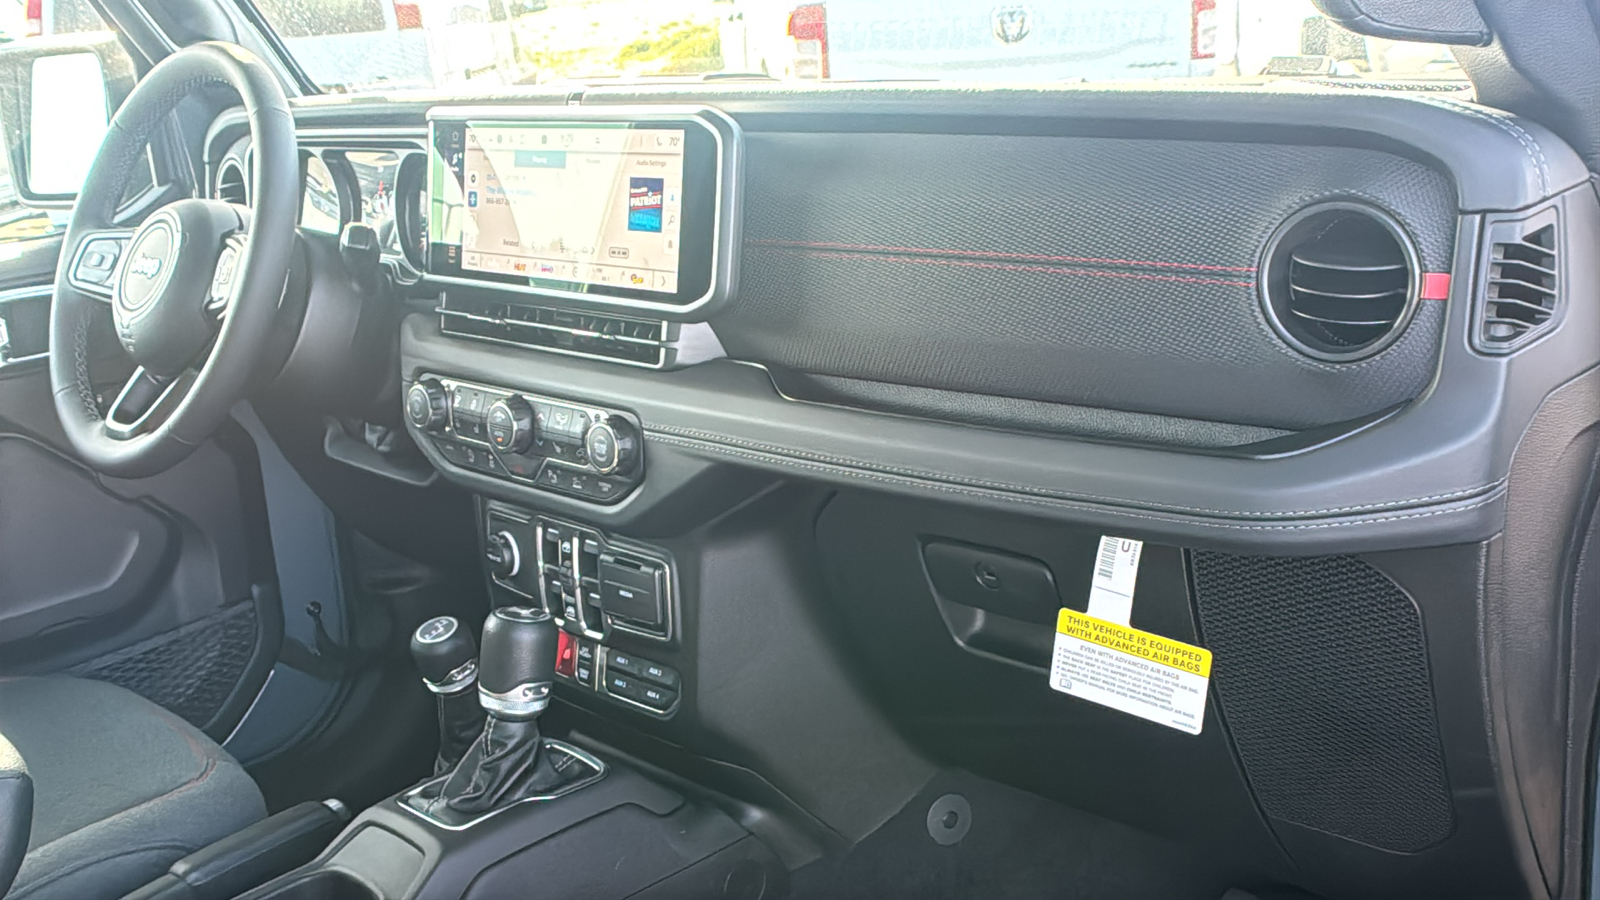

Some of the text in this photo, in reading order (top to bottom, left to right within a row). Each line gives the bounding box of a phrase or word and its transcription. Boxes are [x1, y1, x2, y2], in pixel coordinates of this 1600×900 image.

[636, 159, 667, 168] Audio Settings
[630, 194, 662, 207] PATRIOT
[131, 252, 163, 280] Jeep
[1066, 625, 1200, 672] WITH ADVANCED AIR BAGS
[1067, 615, 1202, 662] THIS VEHICLE IS EQUIPPED
[1063, 648, 1084, 658] CHILDREN
[1080, 645, 1180, 680] EVEN WITH ADVANCED AIR BAGS
